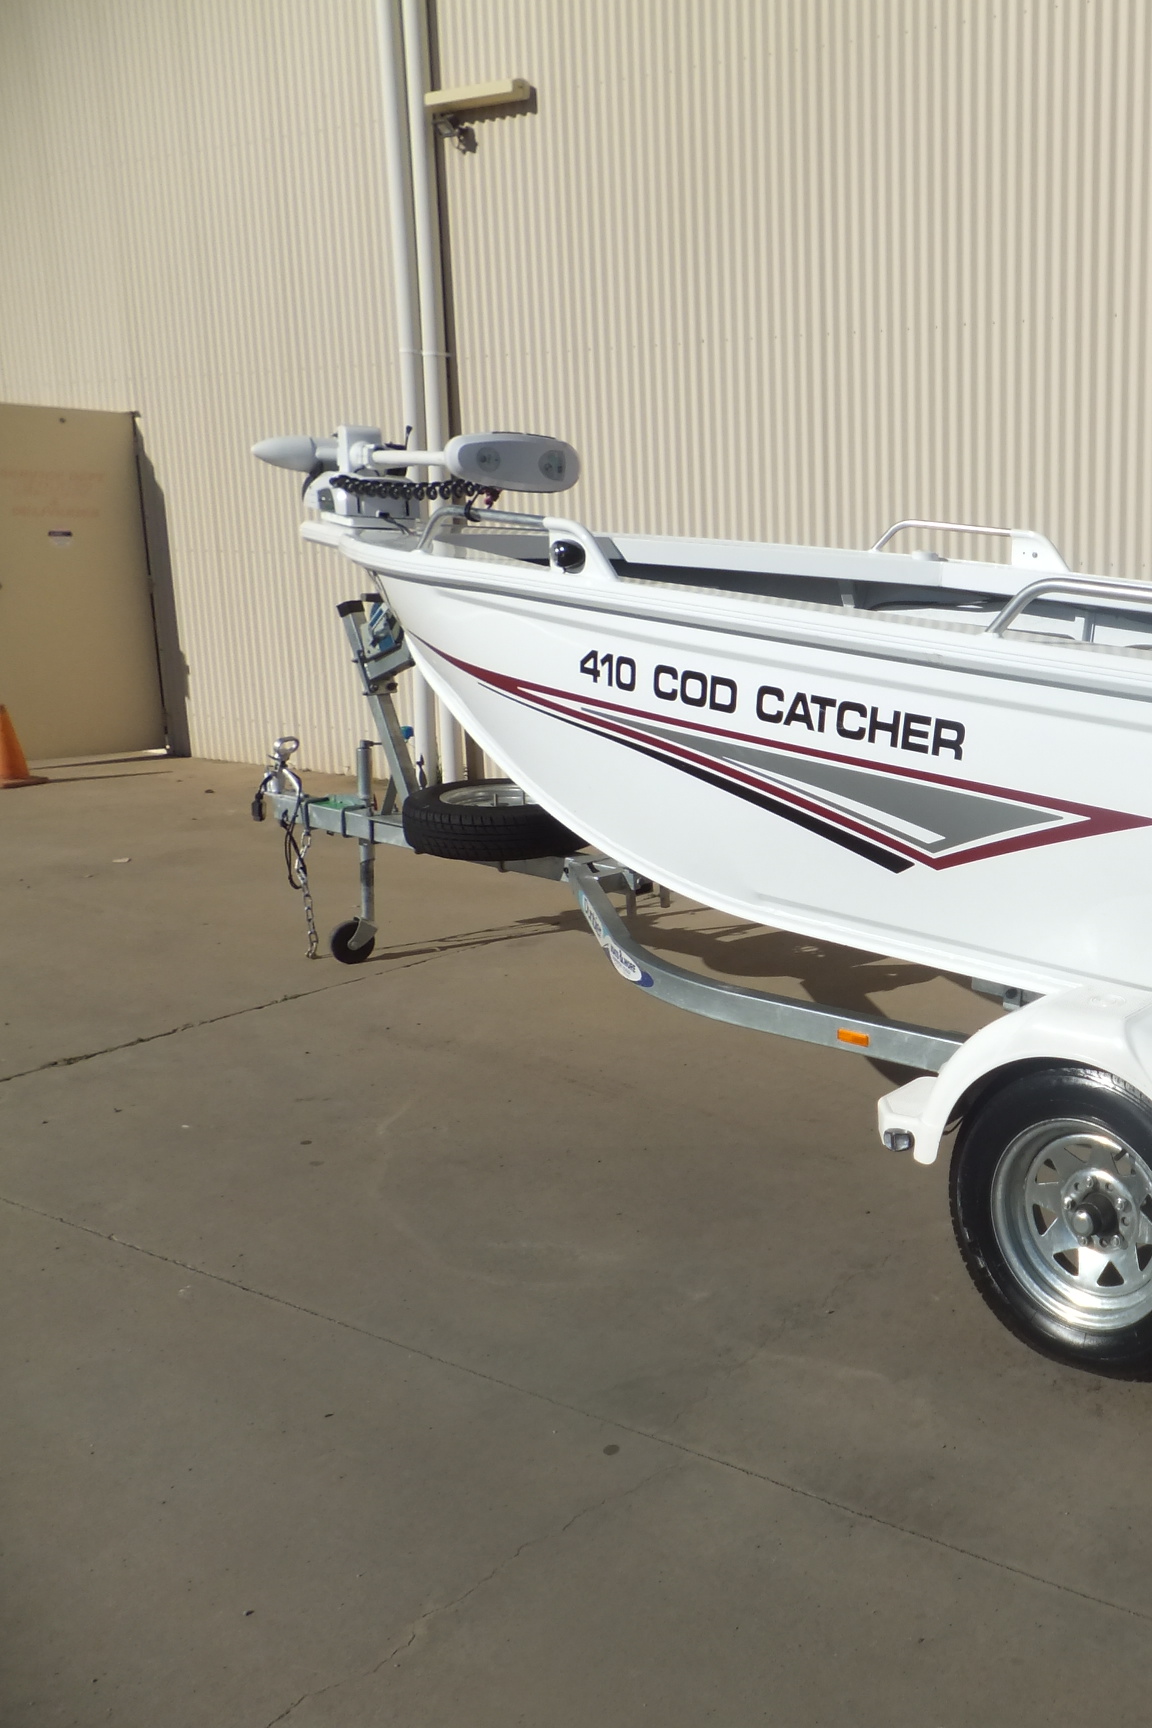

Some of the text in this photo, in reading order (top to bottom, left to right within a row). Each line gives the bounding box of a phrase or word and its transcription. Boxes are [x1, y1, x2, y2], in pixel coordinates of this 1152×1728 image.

[579, 650, 966, 761] 410 COD CATCHER
